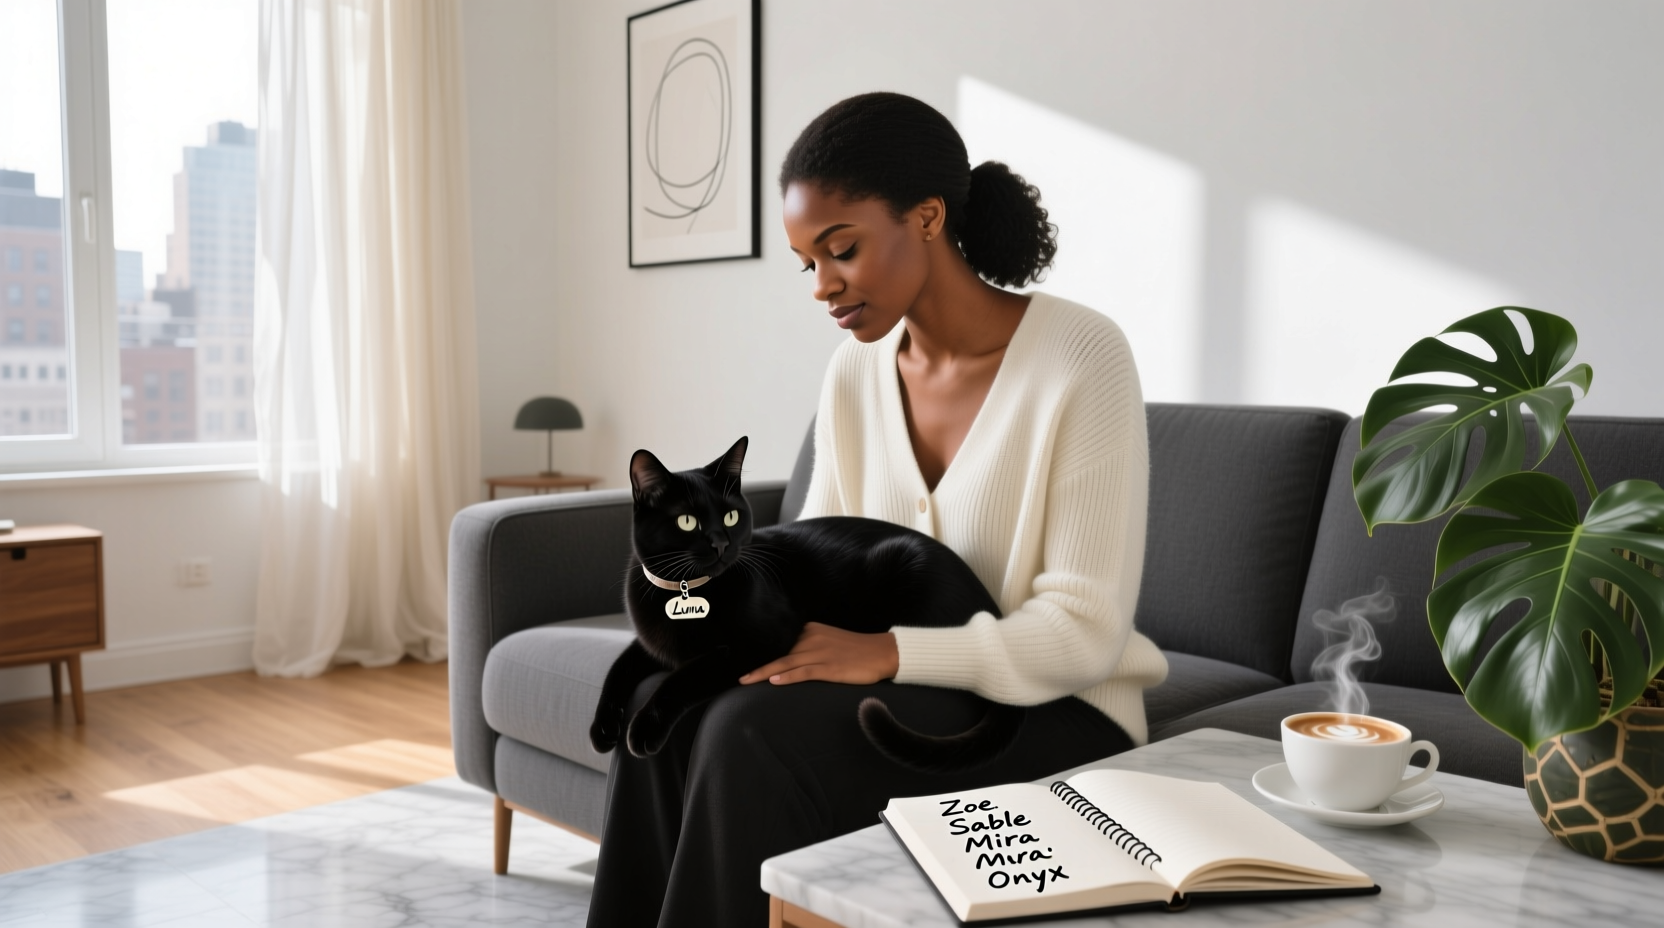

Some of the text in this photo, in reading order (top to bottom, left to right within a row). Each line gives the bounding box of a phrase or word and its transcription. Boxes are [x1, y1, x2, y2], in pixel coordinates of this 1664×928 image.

[939, 799, 999, 817] Zoe
[949, 810, 1032, 836] Sable
[965, 833, 1040, 853] Mira
[988, 865, 1070, 893] Onyx
